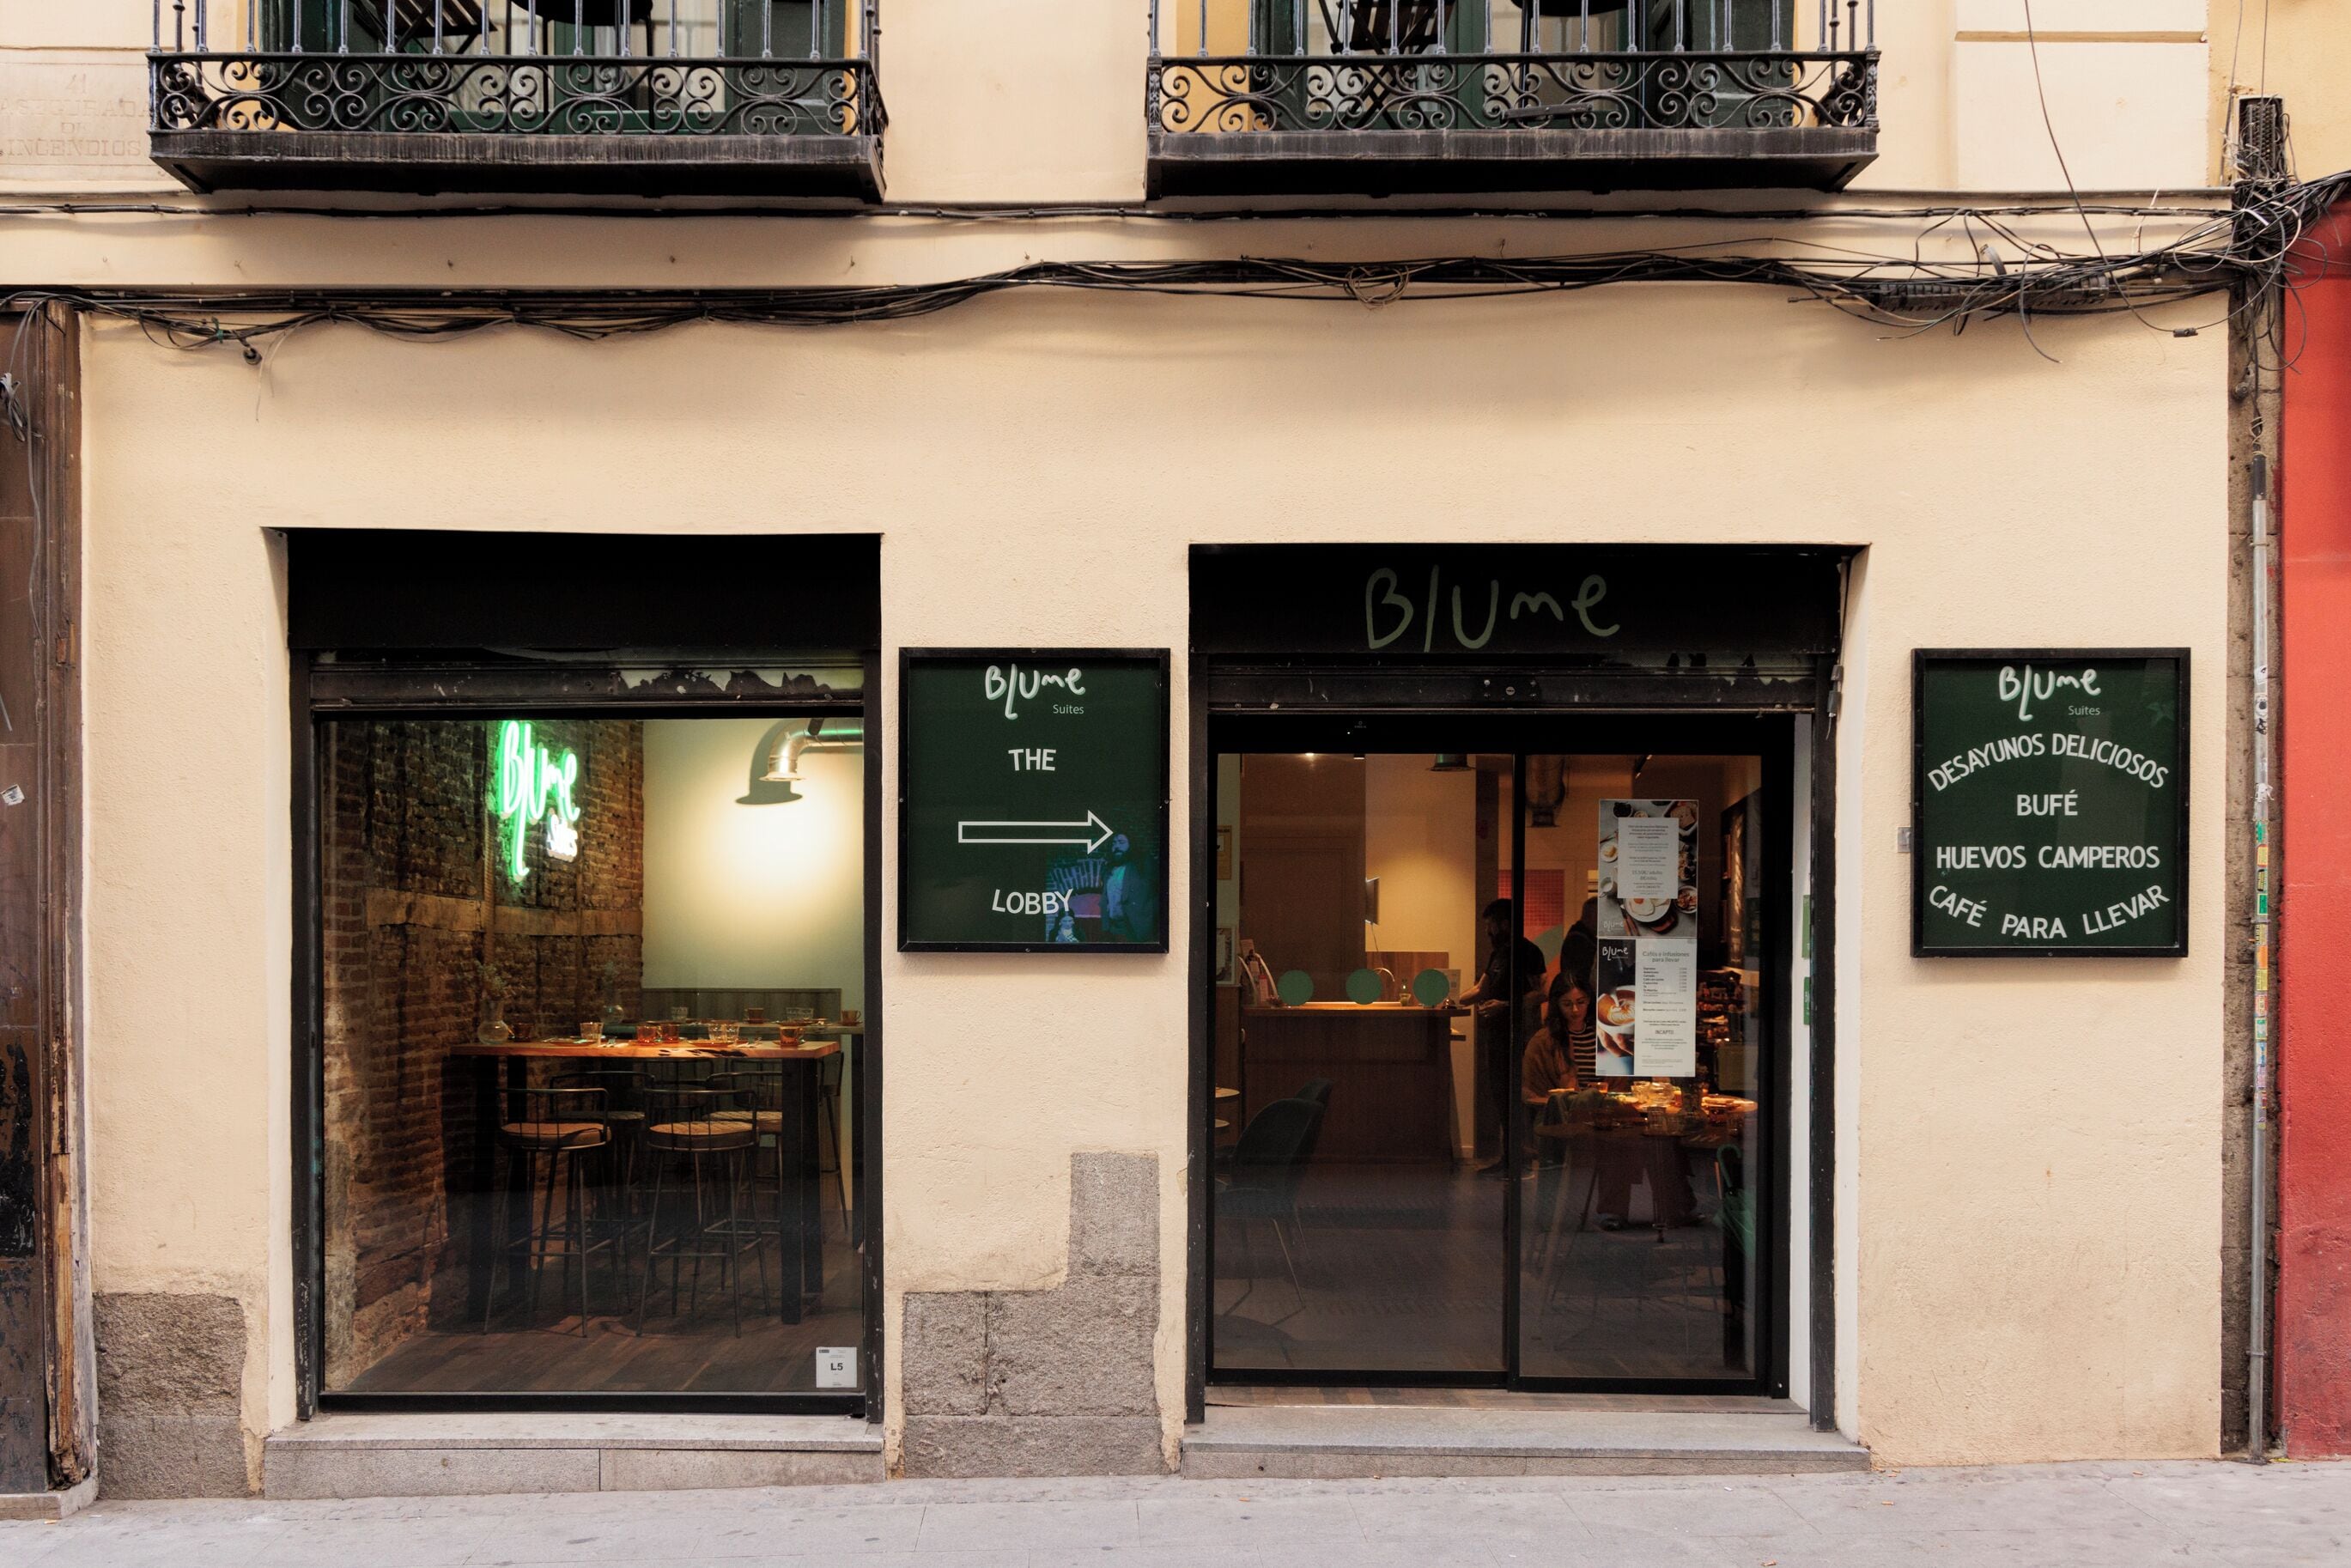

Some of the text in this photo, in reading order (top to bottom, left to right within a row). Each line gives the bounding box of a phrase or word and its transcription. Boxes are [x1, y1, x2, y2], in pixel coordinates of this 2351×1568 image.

[7, 139, 142, 157] INCENDIOS
[1365, 565, 1619, 653] Blume
[985, 664, 1086, 720] Blume
[1998, 665, 2102, 721] Blume
[1053, 703, 1084, 714] Suites
[2068, 705, 2101, 715] Suites
[1008, 749, 1057, 771] THE
[1928, 733, 2169, 791] DESAYUNOS DELICIOSOS
[2017, 789, 2079, 816] BUFÉ
[1936, 846, 2160, 869] HUEVOS CAMPEROS
[992, 888, 1073, 915] LOBBY
[1929, 884, 2171, 939] CAFÉ PARA LLEVAR
[1602, 945, 1629, 961] Blume
[830, 1362, 843, 1371] L5
